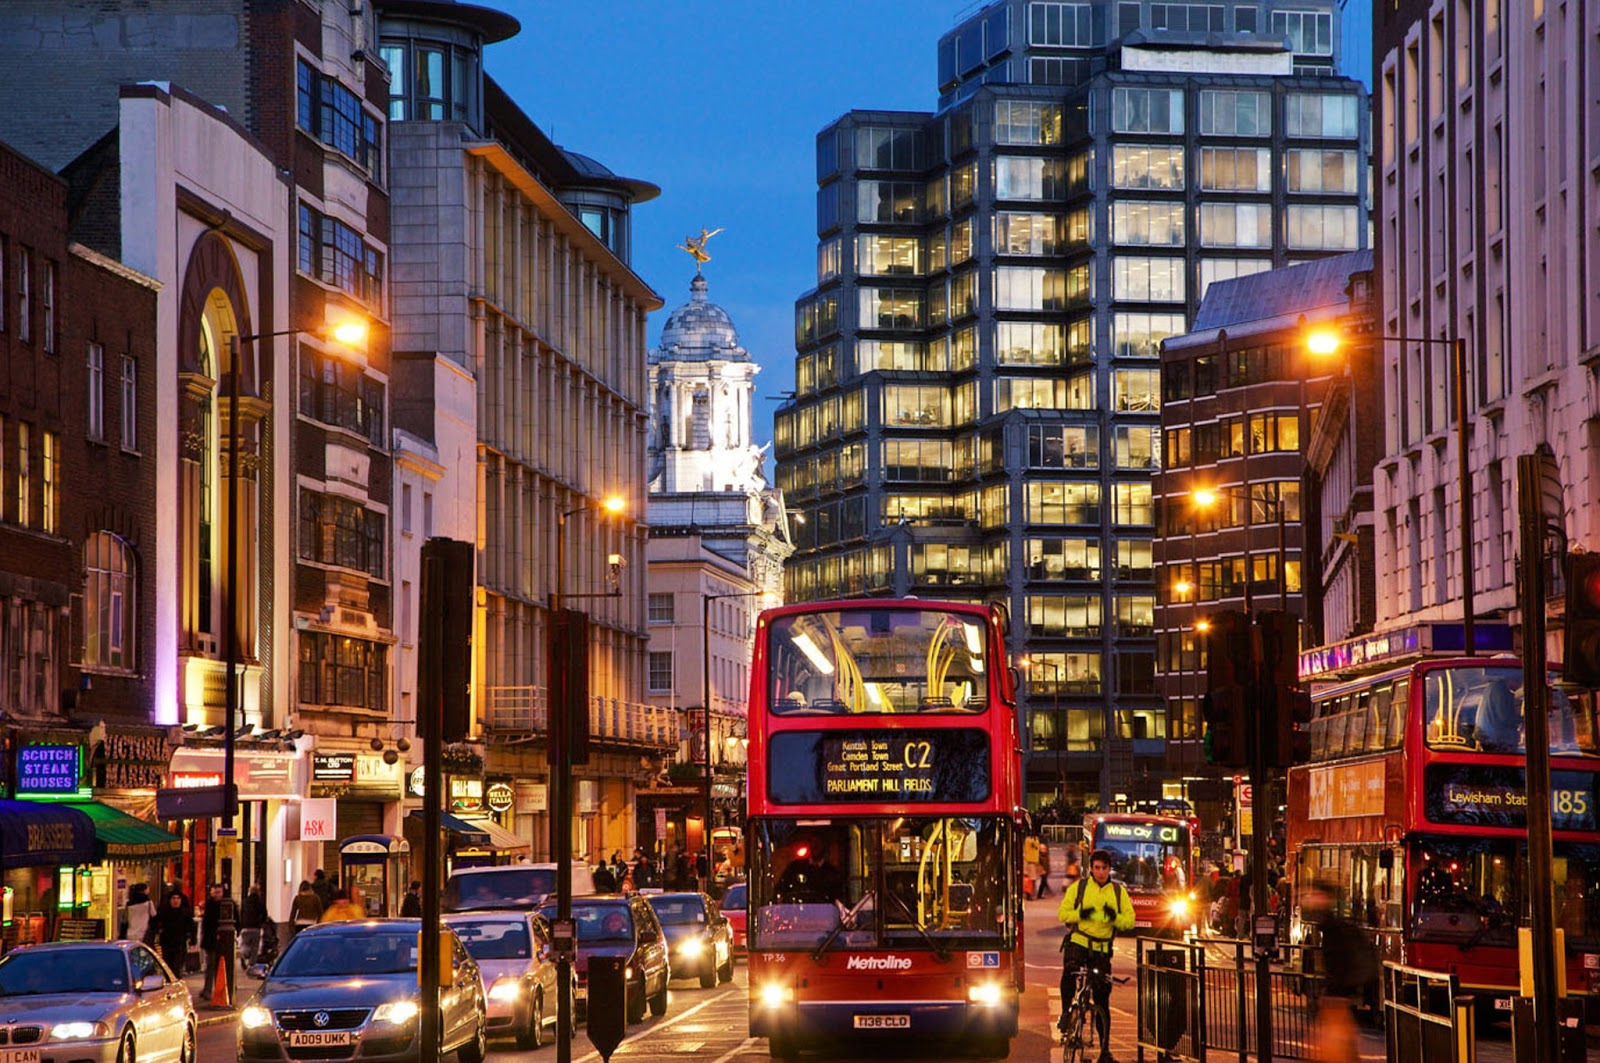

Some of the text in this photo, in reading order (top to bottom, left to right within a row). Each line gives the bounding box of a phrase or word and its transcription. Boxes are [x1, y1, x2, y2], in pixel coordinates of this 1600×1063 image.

[103, 734, 170, 761] VICTORIA
[871, 740, 888, 750] Town
[22, 750, 73, 761] SCOTCH
[841, 751, 889, 761] Camden Town
[904, 741, 931, 768] C2
[24, 763, 69, 775] STEAK
[827, 761, 903, 771] Great Portland Street
[21, 777, 73, 788] HOUSES
[827, 778, 932, 792] PARLIAMENT HILL FIELDS
[1450, 790, 1527, 806] Lewisham Stat
[1553, 789, 1587, 814] 185
[304, 820, 325, 836] ASK
[1107, 826, 1152, 838] White City
[847, 954, 912, 970] Metroline
[324, 1033, 346, 1044] UMK
[14, 1050, 38, 1063] CAN
